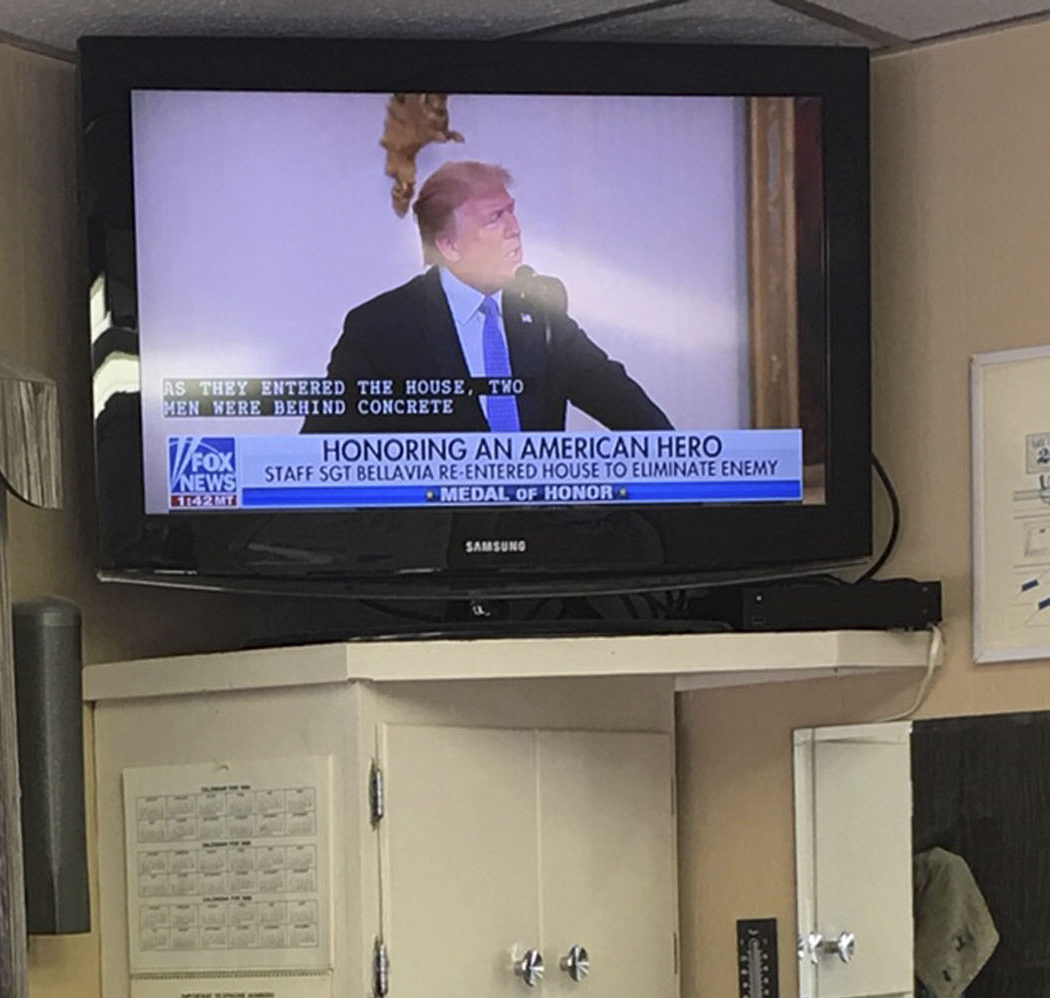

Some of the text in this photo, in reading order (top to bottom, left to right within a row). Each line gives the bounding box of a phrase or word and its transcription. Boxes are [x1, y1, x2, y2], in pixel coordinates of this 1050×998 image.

[164, 378, 524, 396] AS THEY ENTERED THE HOUSE, TWO
[164, 399, 454, 416] MEN WERE BEHIND CONCRETE
[322, 434, 723, 462] HONORING AN AMERICAN HERO
[191, 451, 235, 472] FOX
[265, 459, 779, 482] STAFF SGT BELLAVIA RE-ENTERED HOUSE TO ELIMINATE ENEMY
[180, 473, 237, 492] NEWS
[440, 484, 615, 502] MEDAL OF HONOR
[465, 540, 526, 553] SAMSUNG
